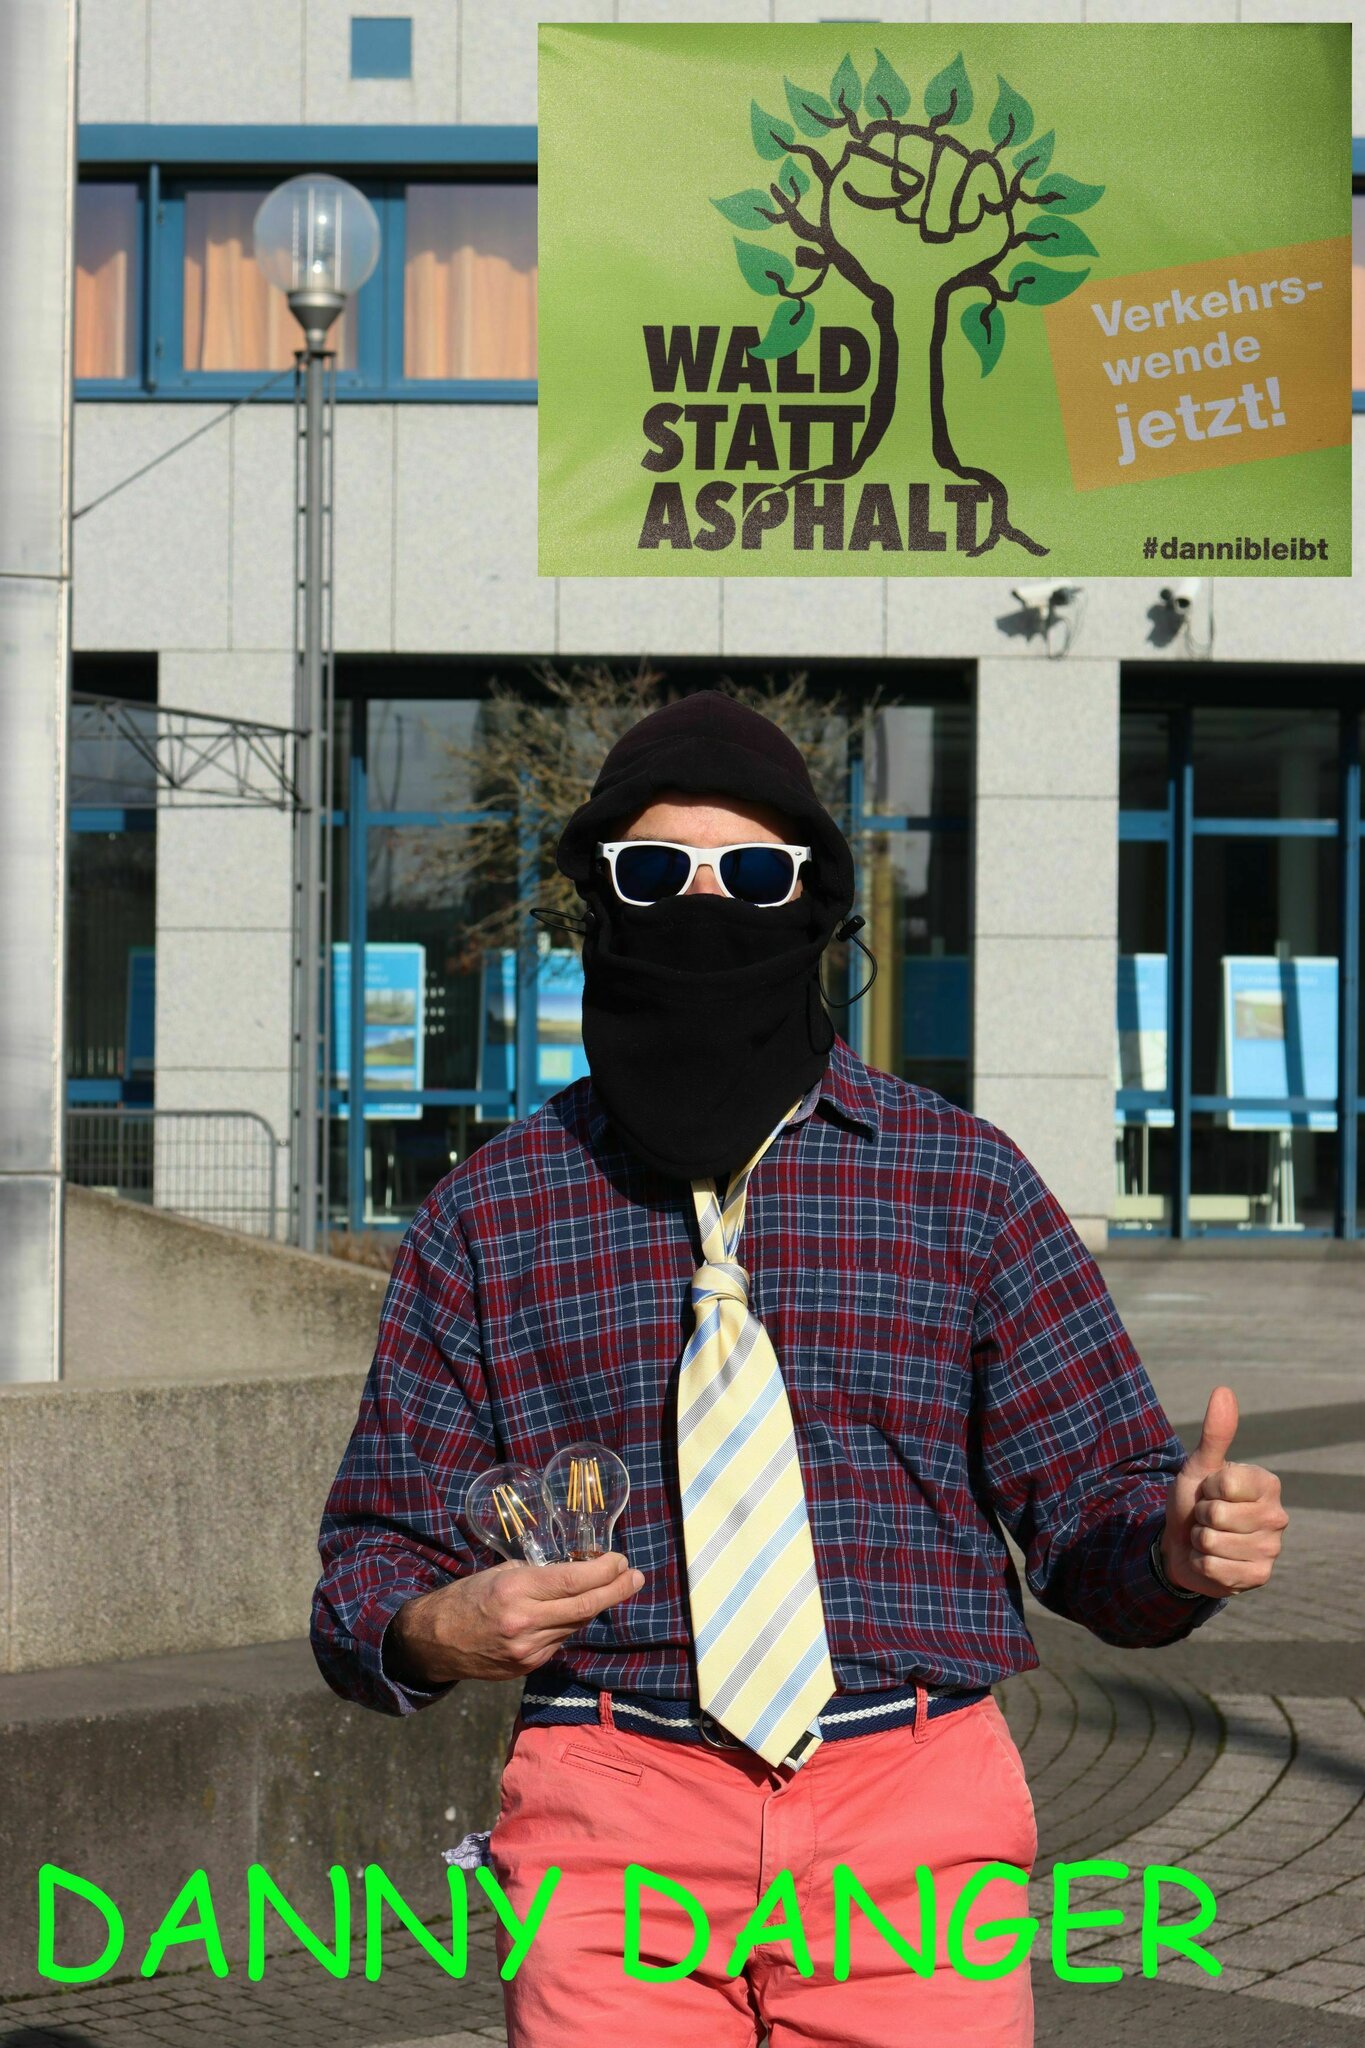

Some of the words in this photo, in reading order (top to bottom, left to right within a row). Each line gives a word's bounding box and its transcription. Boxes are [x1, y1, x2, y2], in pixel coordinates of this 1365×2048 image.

[1091, 275, 1324, 337] Verkehrs-
[641, 324, 872, 393] WALD
[1102, 331, 1261, 386] wende
[640, 402, 866, 472] STATT
[1114, 375, 1287, 466] jetzt!
[637, 481, 990, 553] ASPHALT
[1141, 535, 1329, 562] #dannibleibt
